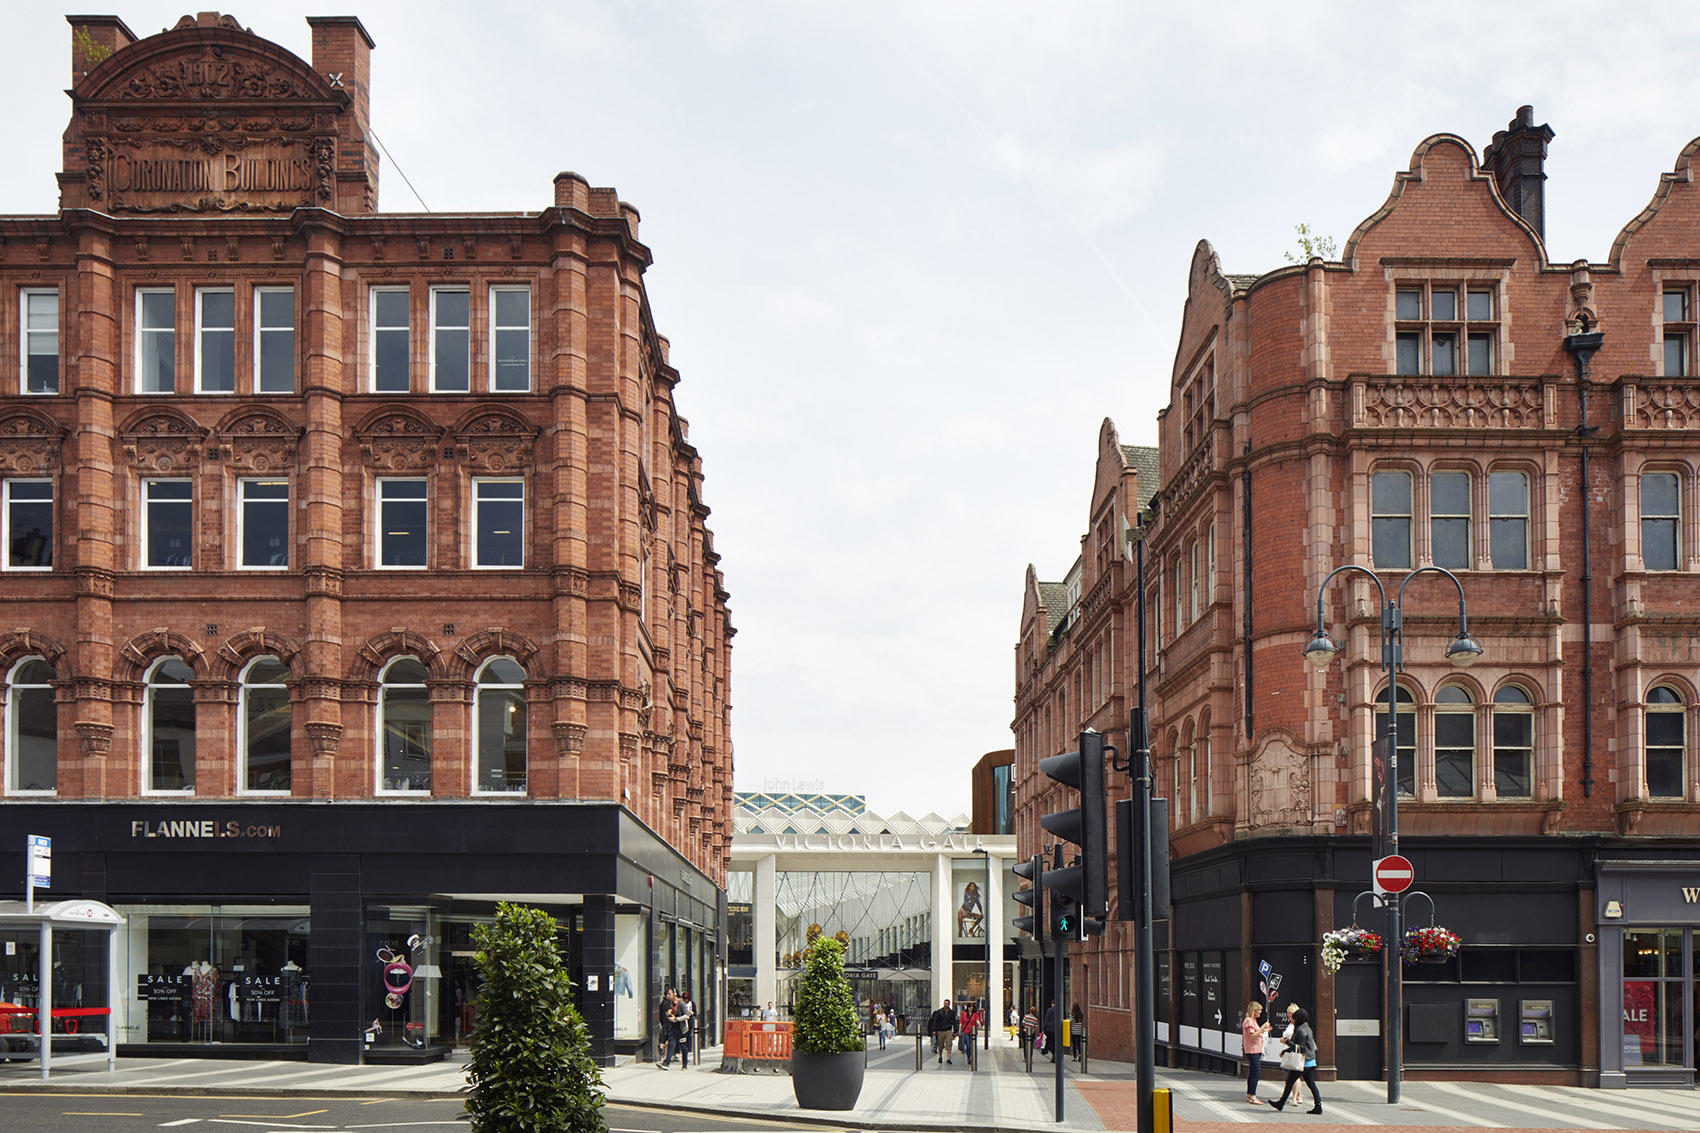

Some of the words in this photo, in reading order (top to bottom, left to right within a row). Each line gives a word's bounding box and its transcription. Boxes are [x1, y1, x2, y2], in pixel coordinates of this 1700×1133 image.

[188, 61, 230, 87] 1902
[112, 154, 211, 193] CORONATION
[222, 154, 312, 193] BUILDINGS
[761, 777, 790, 792] John
[793, 777, 825, 791] Lewis
[132, 820, 281, 837] FLANNELS.COM
[775, 834, 903, 850] VICTORIA
[919, 834, 985, 850] GATE
[1261, 963, 1269, 972] P
[12, 973, 39, 982] SAL
[147, 975, 183, 984] SALE
[245, 976, 281, 985] SALE
[1624, 1008, 1648, 1022] ALE
